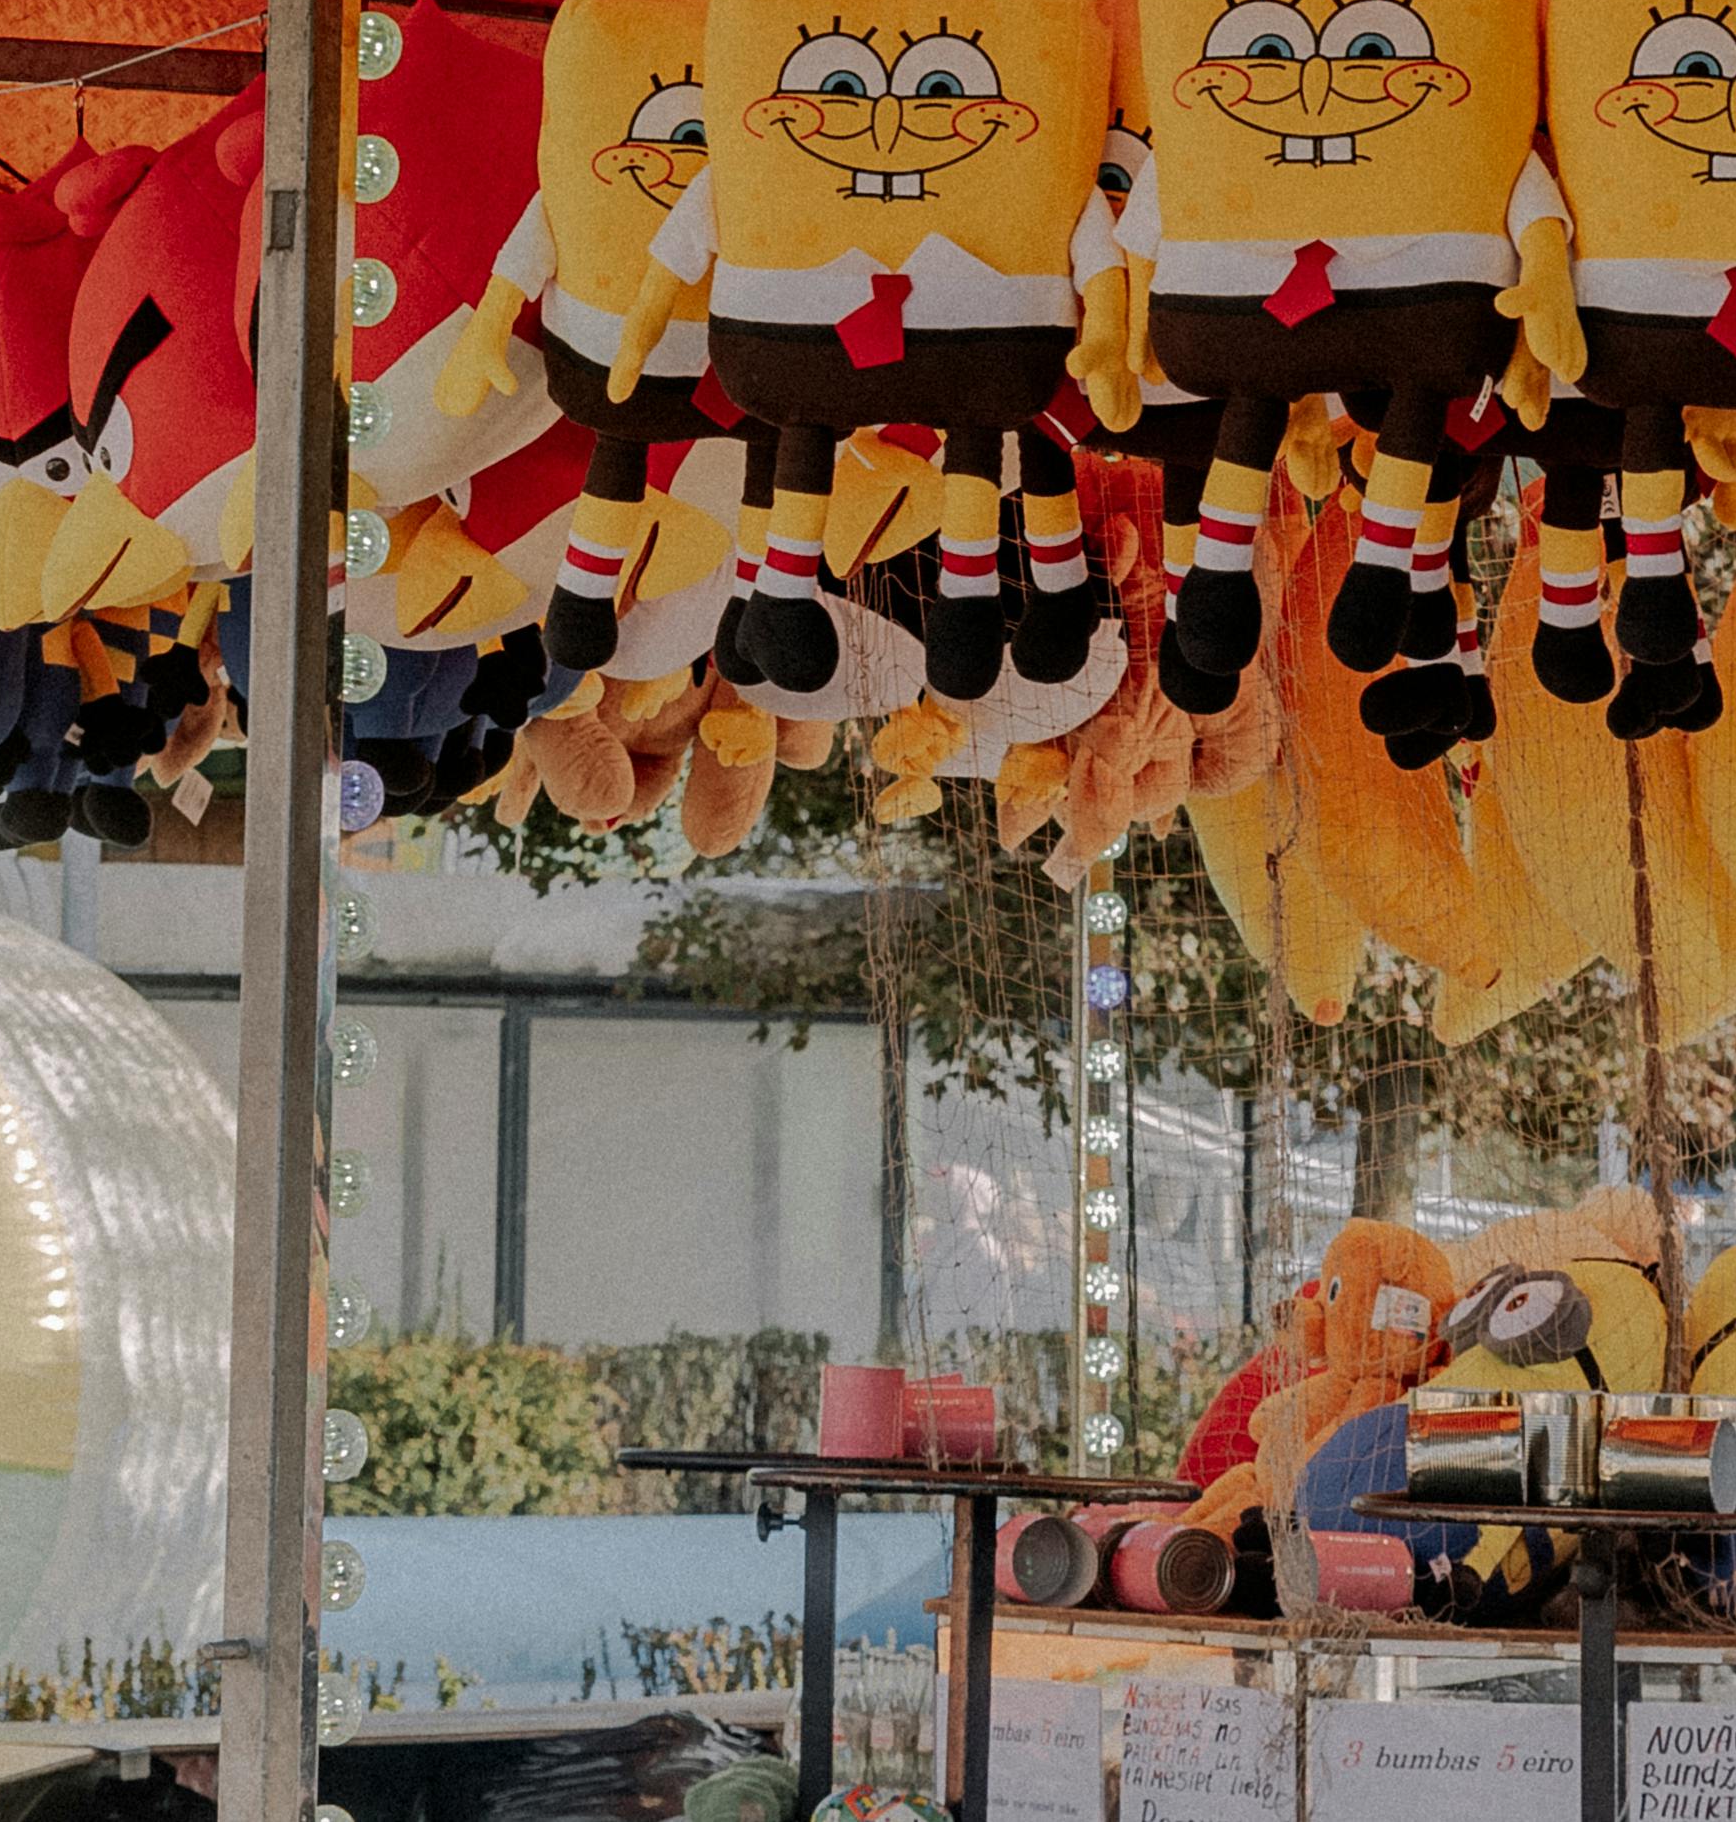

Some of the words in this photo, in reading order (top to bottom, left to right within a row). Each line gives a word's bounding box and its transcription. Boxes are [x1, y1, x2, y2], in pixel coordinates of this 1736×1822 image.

[992, 1720, 1033, 1744] mbas
[1342, 1740, 1364, 1768] 3
[1374, 1745, 1481, 1771] bumbas
[1496, 1744, 1519, 1773] 5
[1522, 1749, 1575, 1774] eiro
